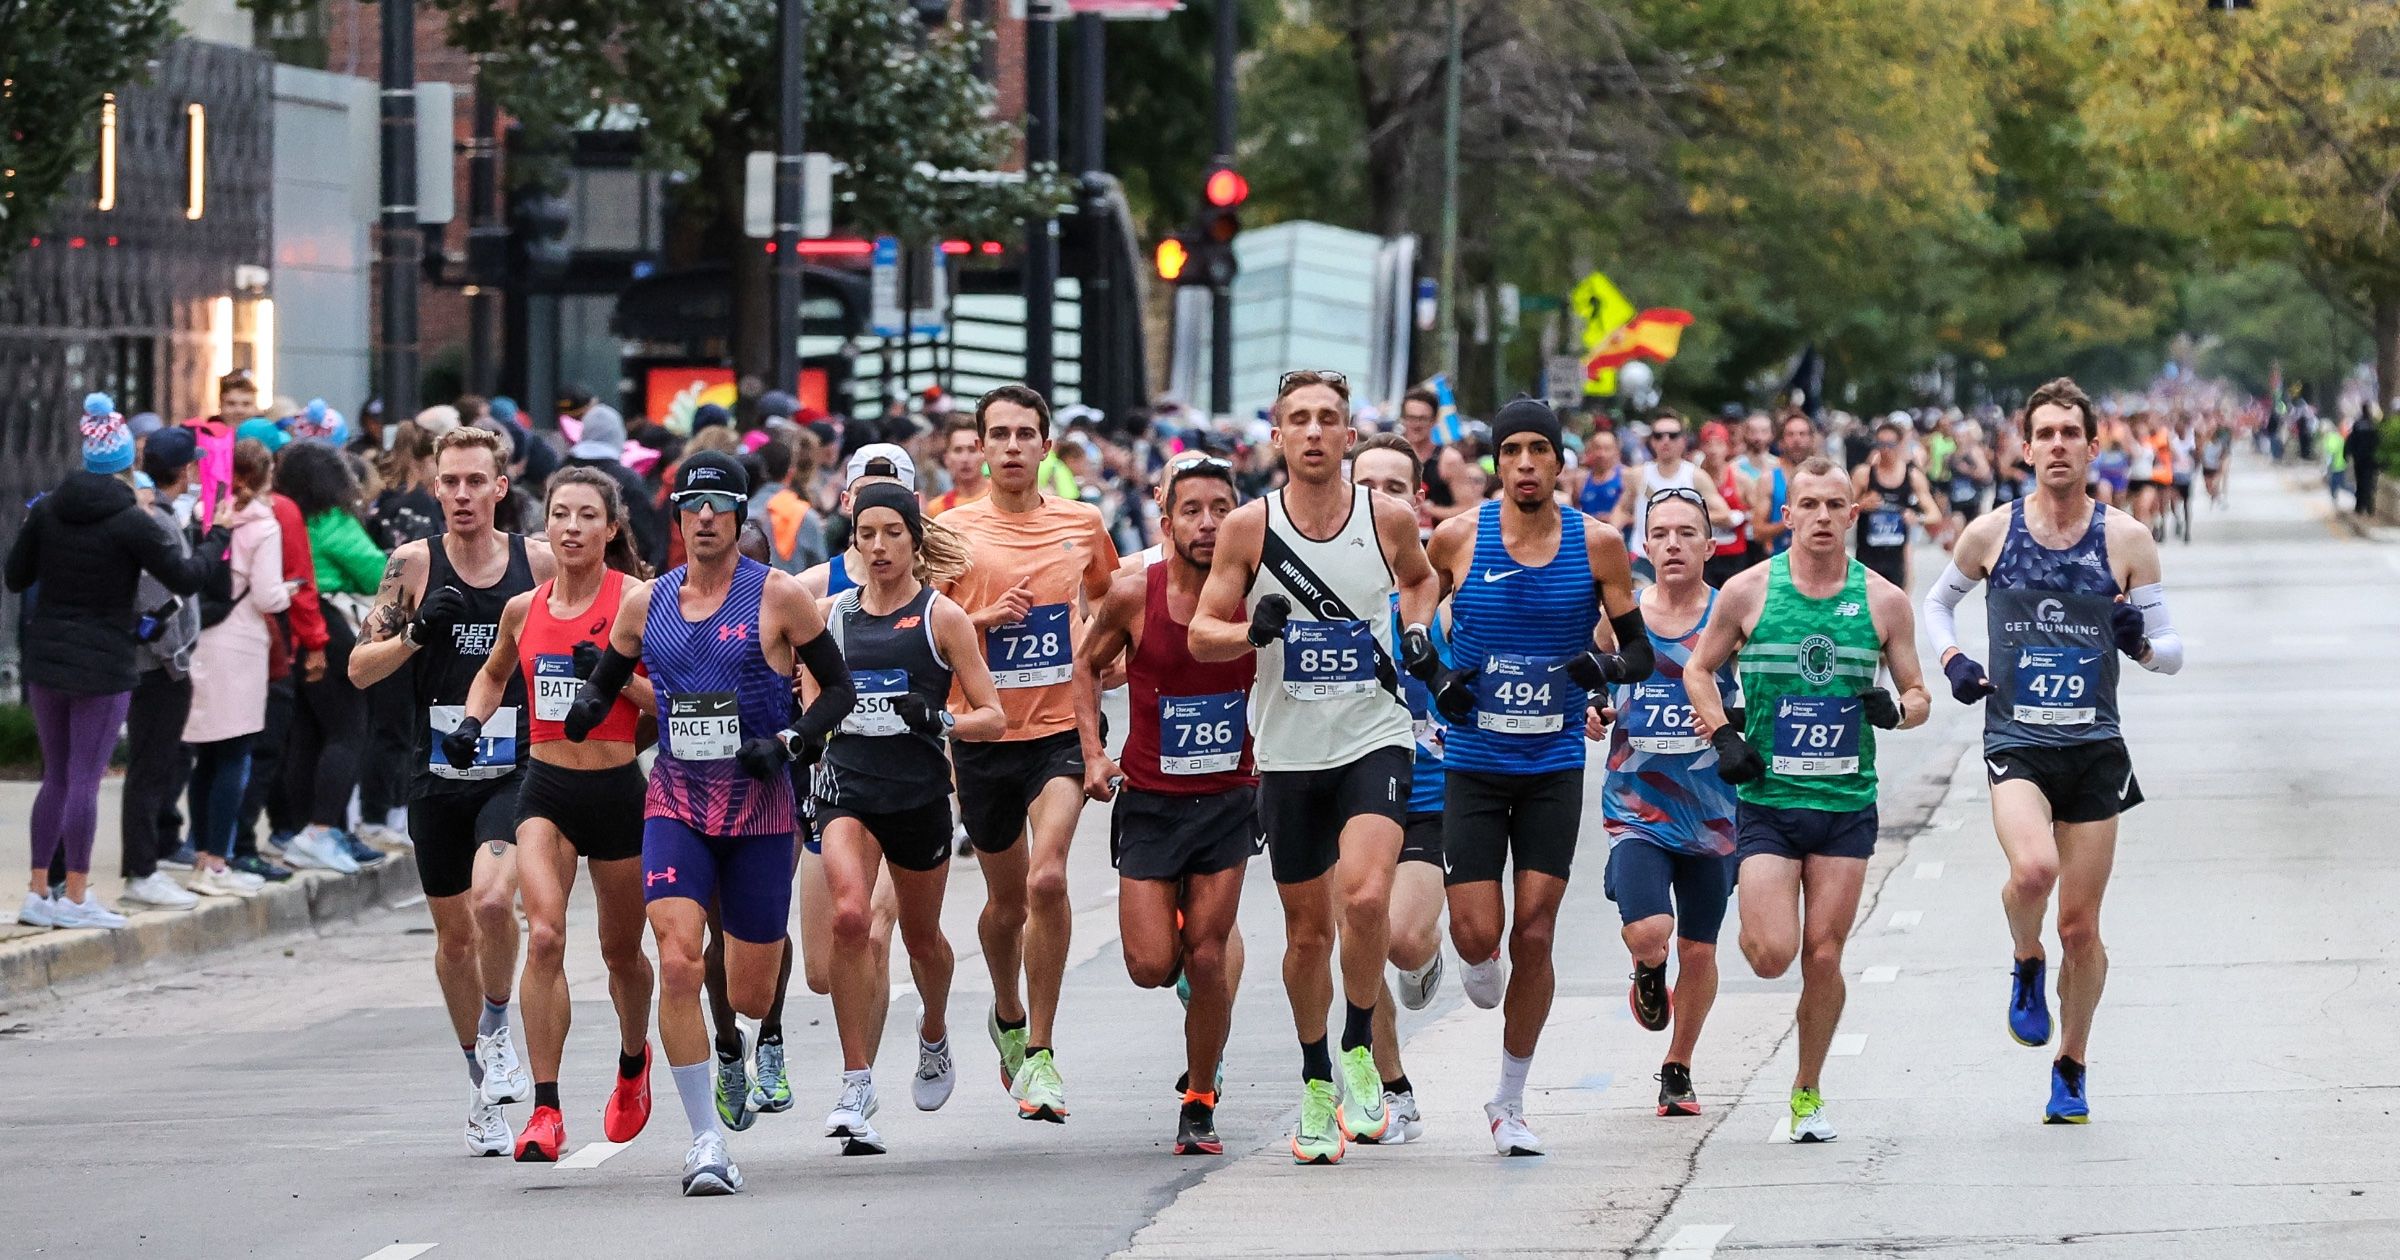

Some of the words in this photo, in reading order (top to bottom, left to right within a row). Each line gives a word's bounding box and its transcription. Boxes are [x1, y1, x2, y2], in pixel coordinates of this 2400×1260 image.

[1279, 560, 1322, 600] INFINITY
[451, 623, 498, 636] FLEET
[2005, 622, 2031, 632] GET
[2037, 622, 2100, 636] RUNNING
[455, 635, 494, 648] FEET
[1003, 632, 1059, 660] 728
[1300, 649, 1359, 673] 855
[1494, 681, 1552, 706] 494
[2029, 674, 2085, 699] 479
[671, 720, 712, 736] PACE
[717, 717, 738, 735] 16
[1644, 704, 1697, 728] 762
[1175, 720, 1233, 748] 786
[1790, 724, 1845, 748] 787
